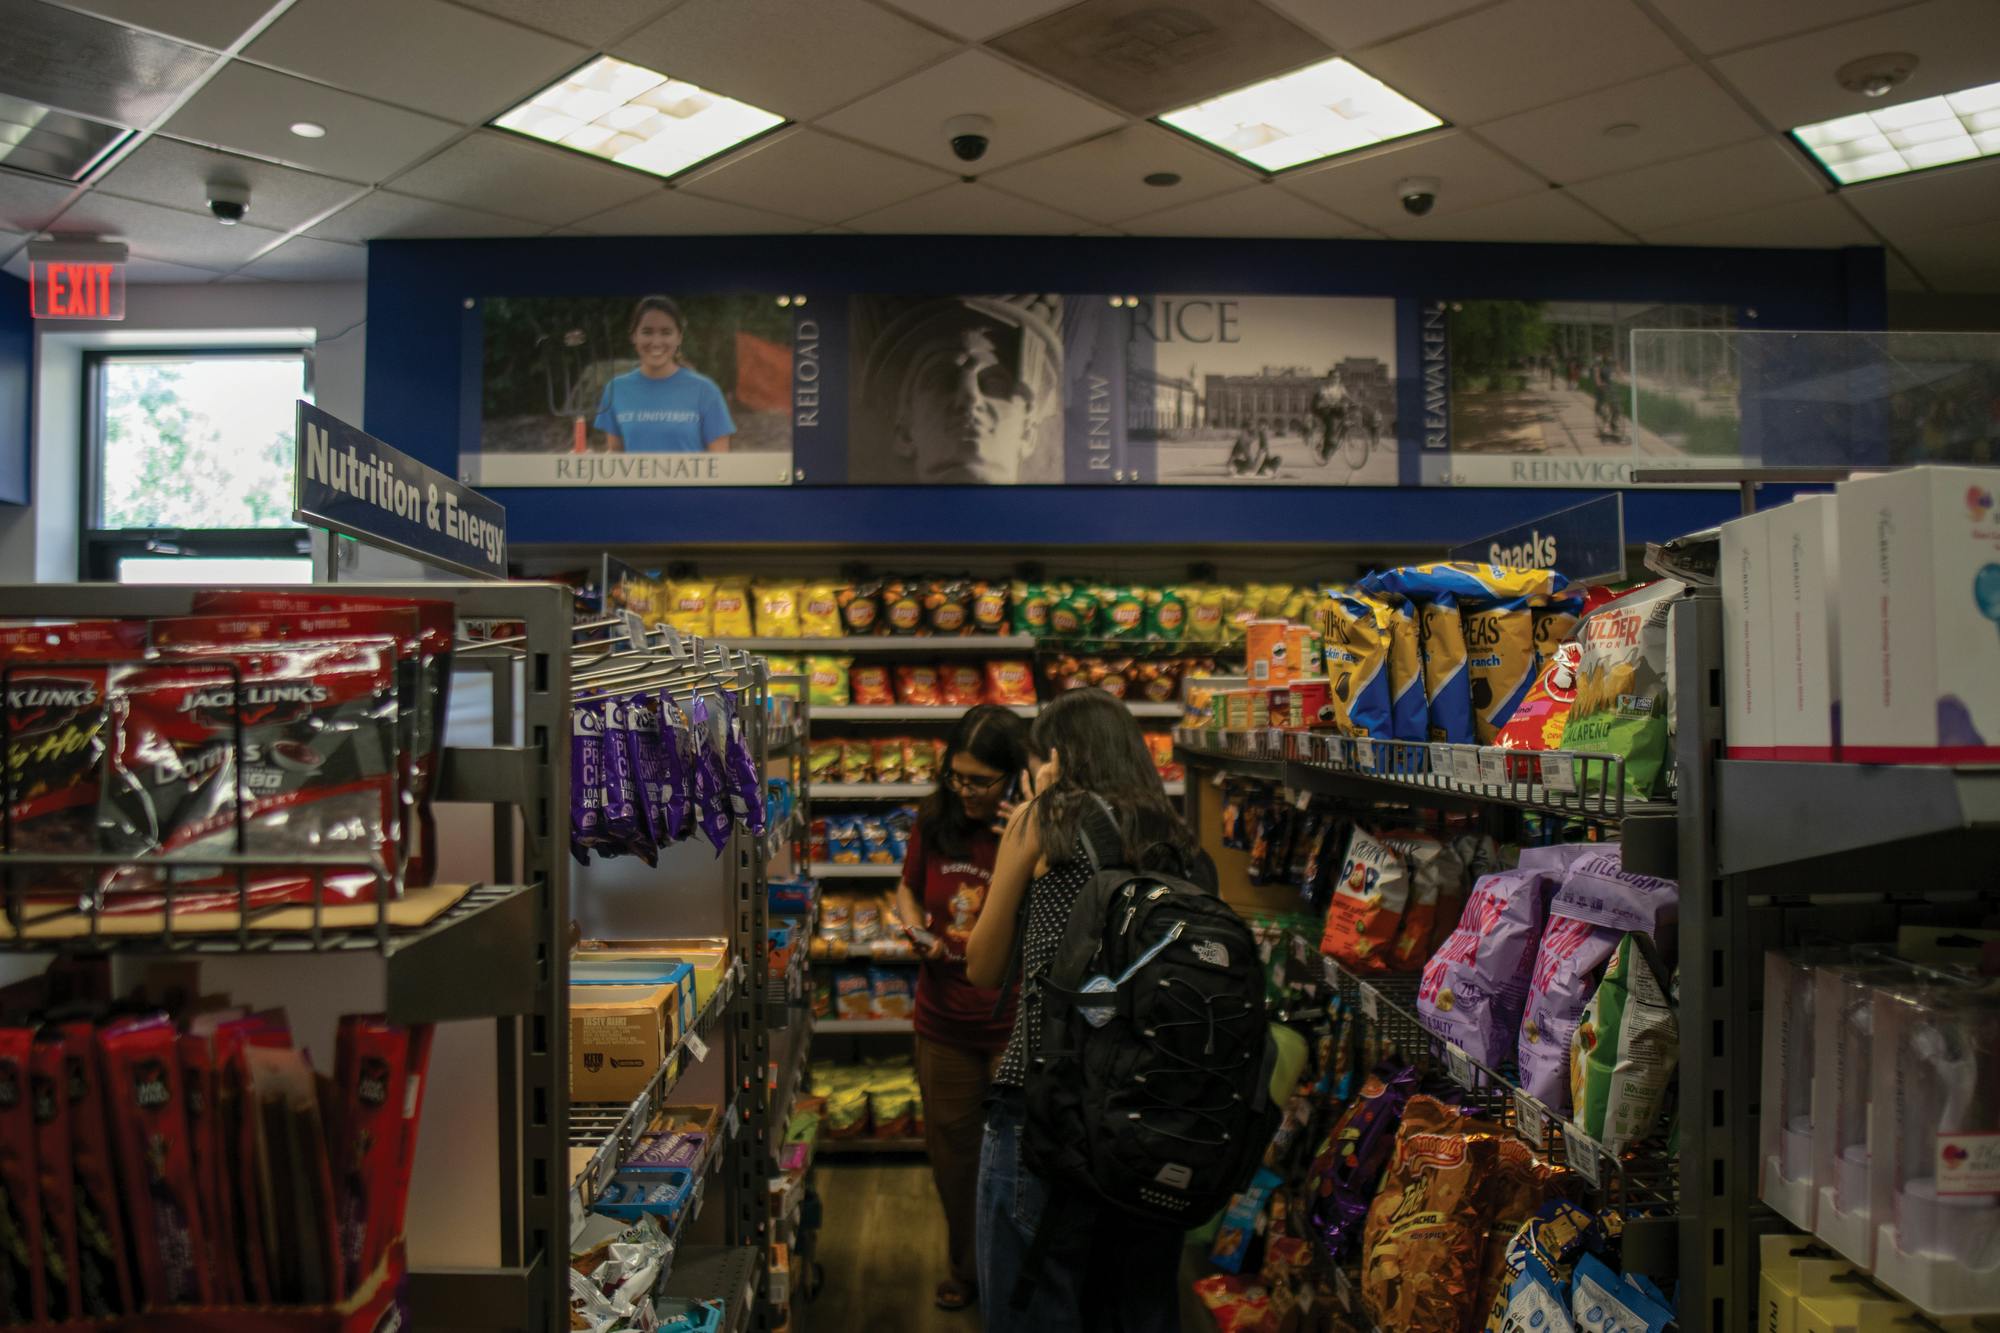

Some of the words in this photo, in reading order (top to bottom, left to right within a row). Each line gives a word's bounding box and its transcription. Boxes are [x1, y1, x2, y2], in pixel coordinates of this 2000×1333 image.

[48, 262, 113, 316] EXIT
[1128, 301, 1240, 344] RICE
[797, 320, 820, 427] RELOAD
[1423, 303, 1448, 448] REAWAKEN
[1089, 376, 1111, 471] RENEW
[555, 455, 720, 484] REJUVENATE
[306, 420, 422, 524] Nutrition
[425, 483, 441, 534] &
[446, 496, 504, 565] Energy
[1489, 529, 1557, 573] Snacks
[1465, 615, 1499, 645] PEAS
[1586, 615, 1641, 647] ULDER
[1472, 654, 1500, 667] ranch
[1519, 1051, 1531, 1065] ALTY
